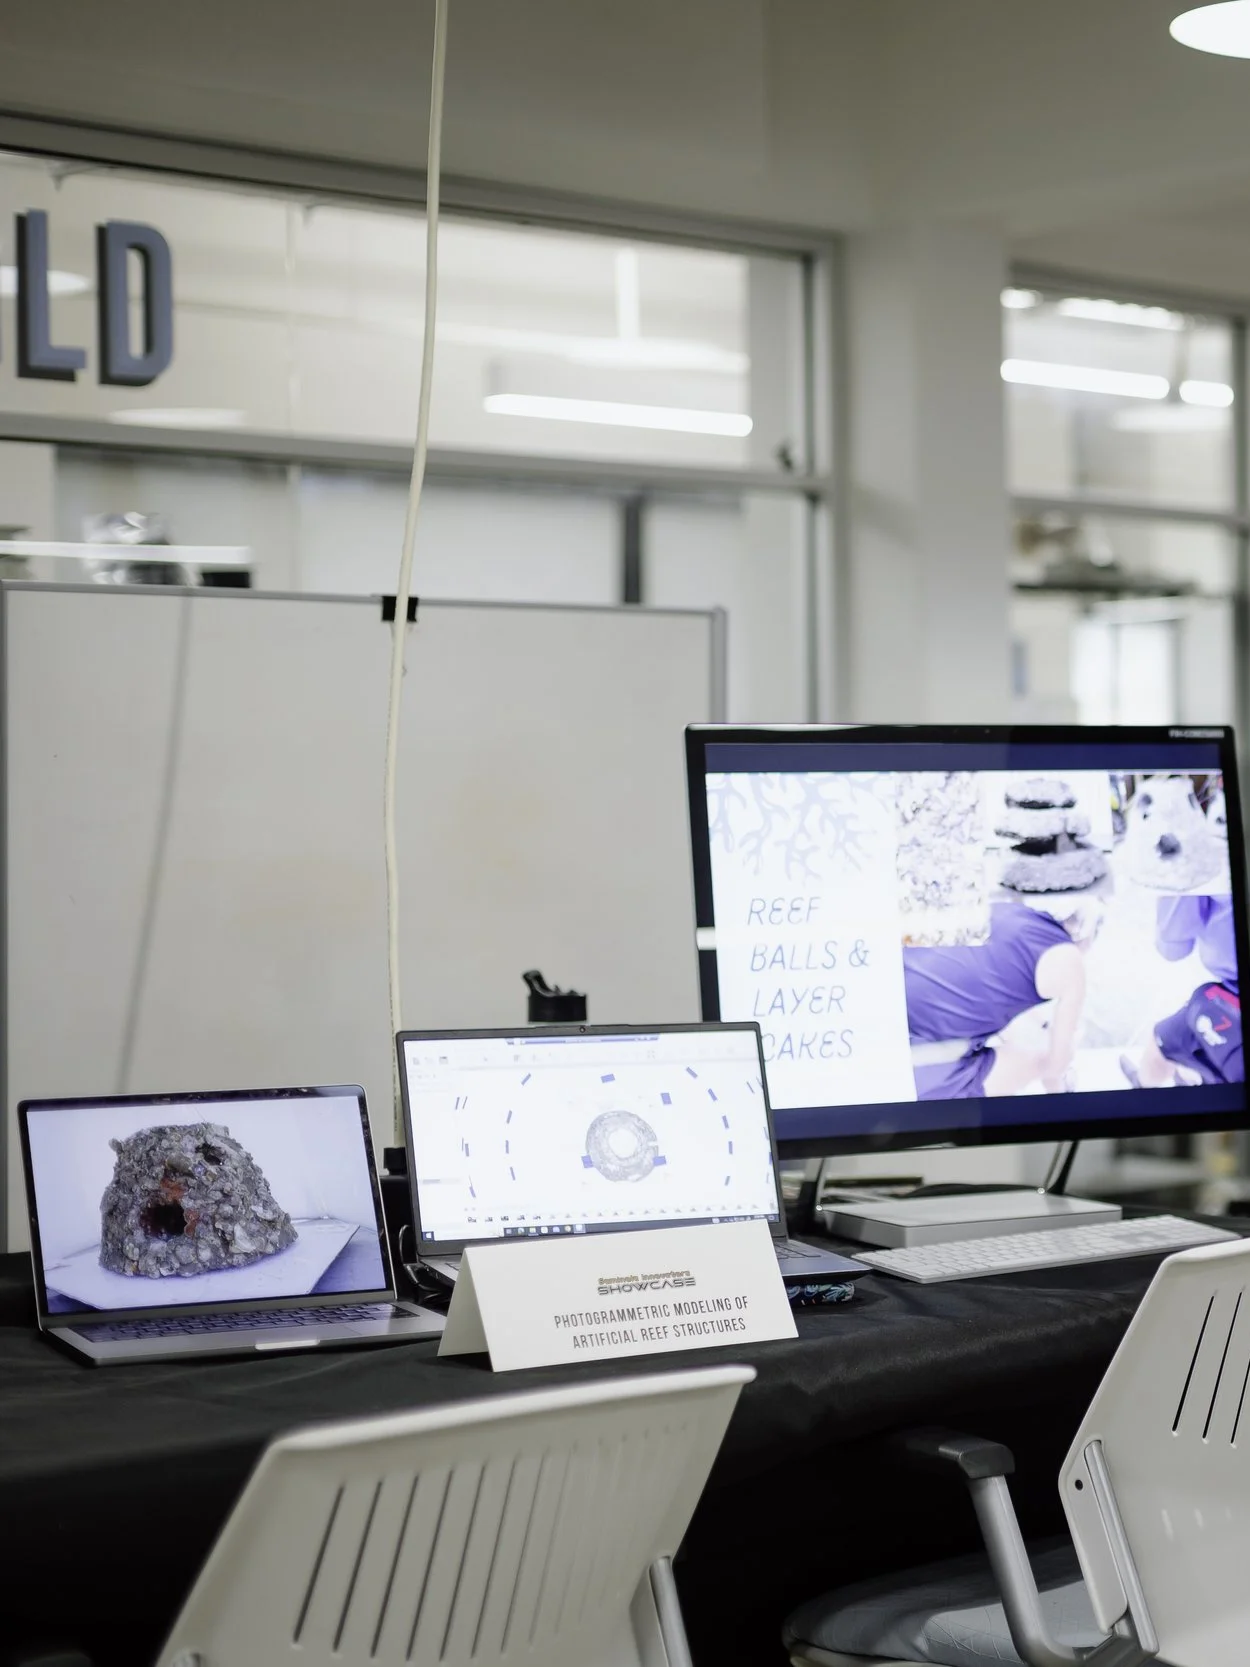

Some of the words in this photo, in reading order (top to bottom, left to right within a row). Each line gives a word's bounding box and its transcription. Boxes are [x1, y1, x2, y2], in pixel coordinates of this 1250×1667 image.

[0, 207, 174, 387] LD
[747, 896, 822, 926] REEF
[750, 939, 838, 972] BALLS
[848, 938, 870, 968] &
[753, 985, 846, 1017] LAYER
[761, 1028, 854, 1063] CAKES
[597, 1277, 696, 1296] SHOWCASE
[554, 1304, 671, 1329] PHOTOGRAMMETRIC
[673, 1297, 732, 1317] MODELING
[734, 1295, 749, 1311] OF
[572, 1330, 639, 1350] ARTIFICIAL
[640, 1325, 670, 1343] REEF
[672, 1317, 747, 1339] STRUCTURES
